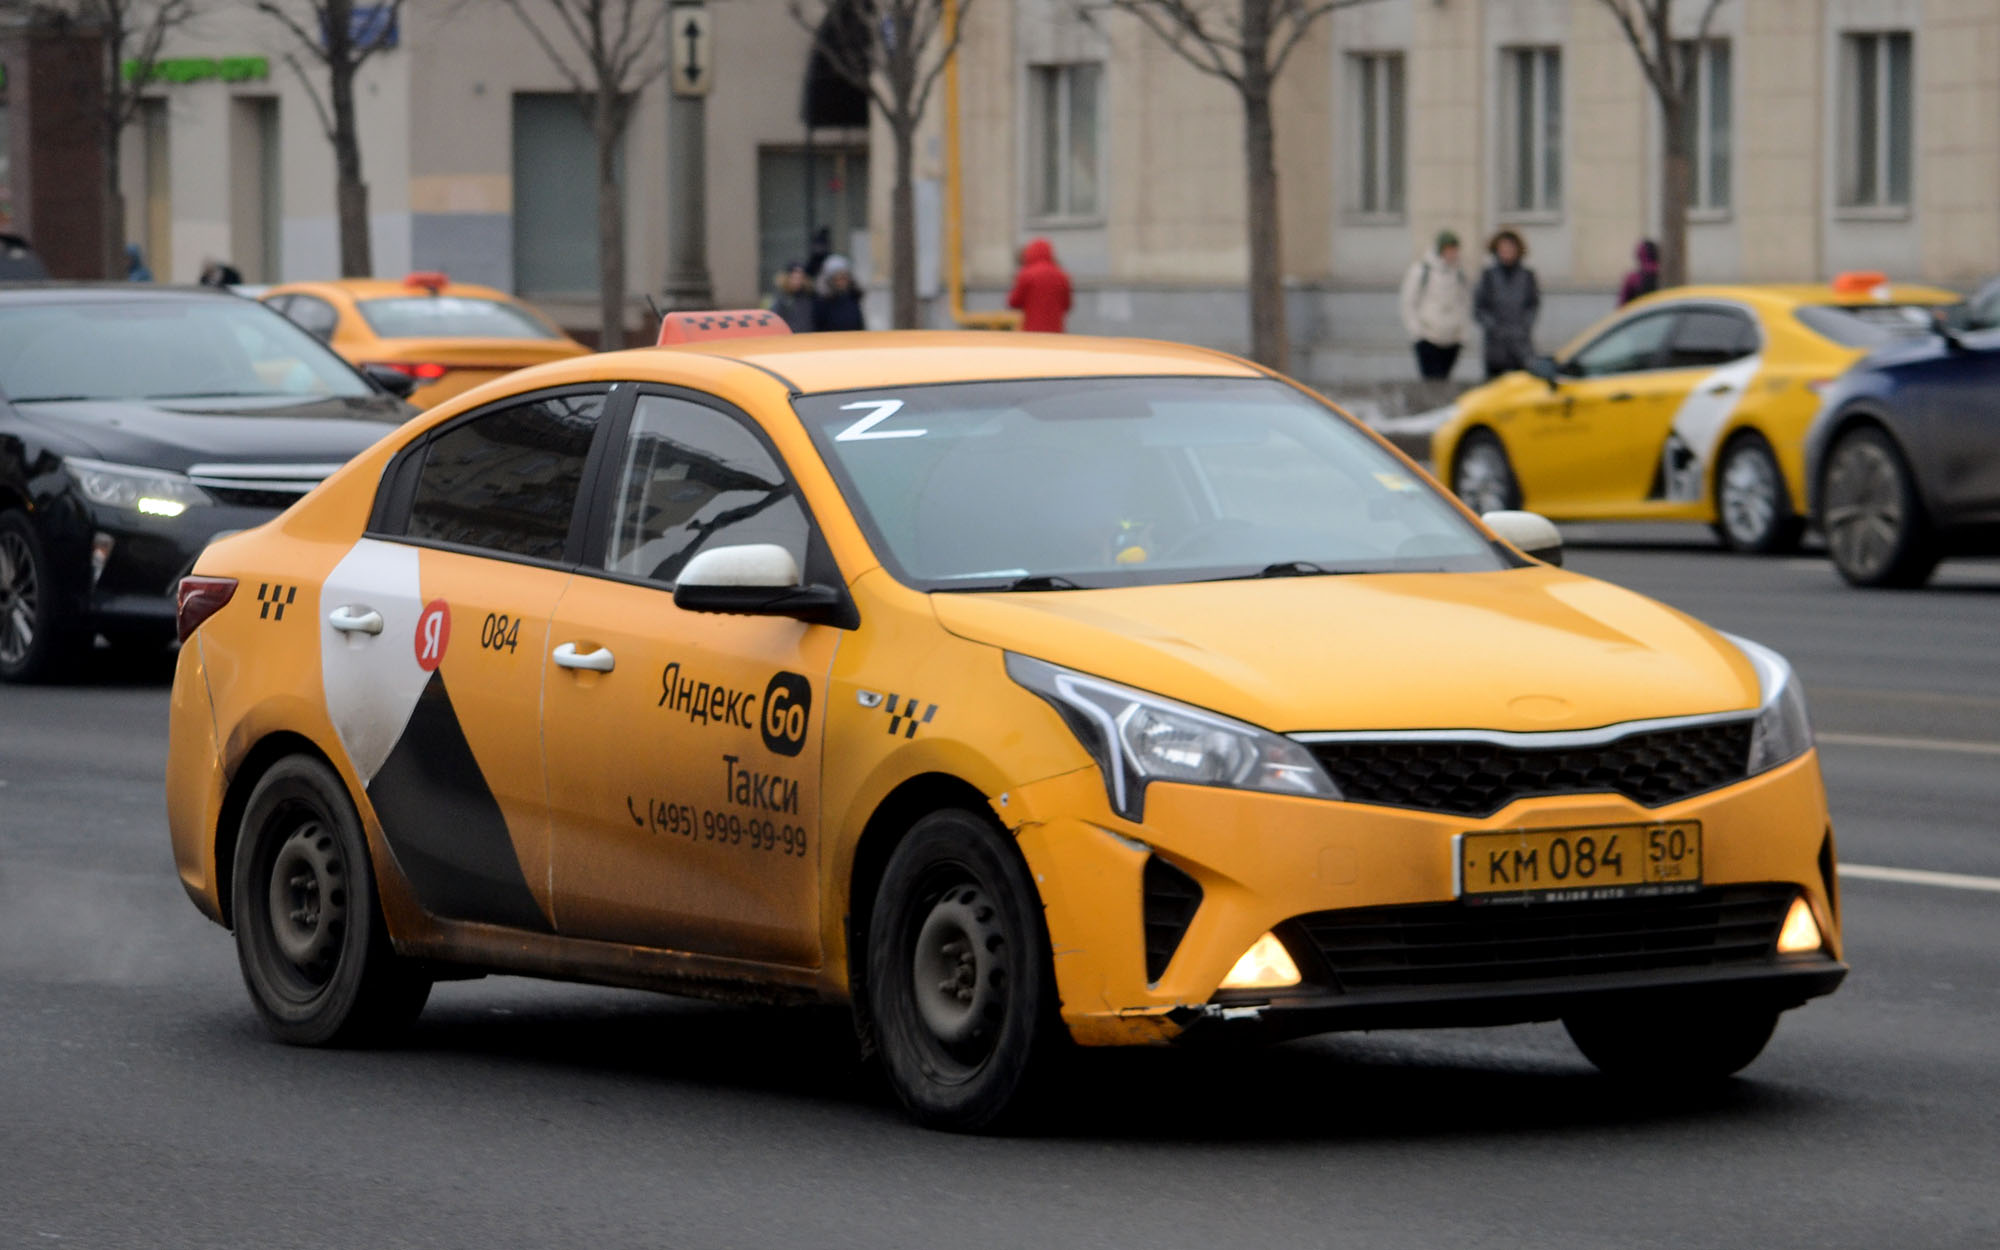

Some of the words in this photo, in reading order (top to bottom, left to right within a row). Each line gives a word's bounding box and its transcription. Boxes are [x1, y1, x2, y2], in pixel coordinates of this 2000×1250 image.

[835, 399, 929, 442] Z
[422, 610, 443, 660] Я
[481, 612, 521, 655] 084
[658, 661, 756, 730] Яндекс
[765, 685, 805, 742] Go
[722, 753, 799, 816] Такси
[649, 797, 698, 842] (495)
[703, 809, 808, 858] 999-99-99
[1649, 829, 1687, 862] 50
[1549, 834, 1623, 880] 084
